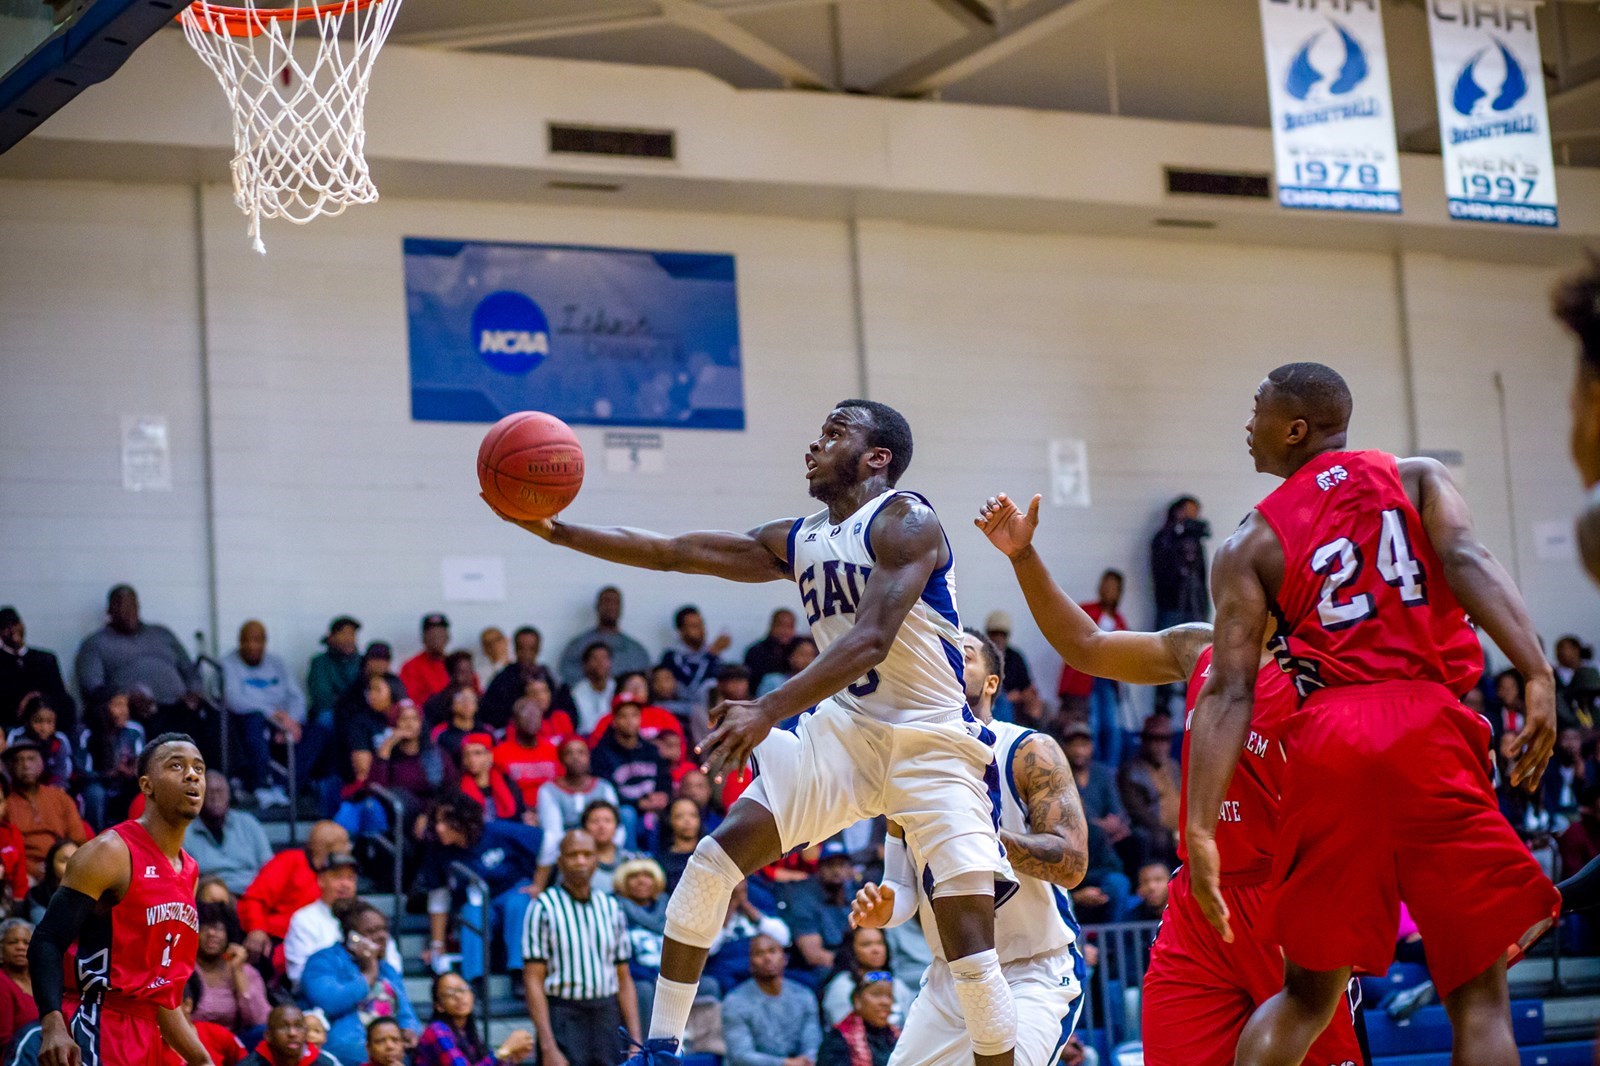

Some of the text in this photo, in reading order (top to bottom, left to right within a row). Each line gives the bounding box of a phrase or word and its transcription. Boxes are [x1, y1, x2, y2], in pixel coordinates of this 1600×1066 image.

[1295, 160, 1379, 187] 1978
[1462, 174, 1537, 200] 1997
[480, 330, 548, 355] NCAA
[1310, 508, 1430, 632] 24
